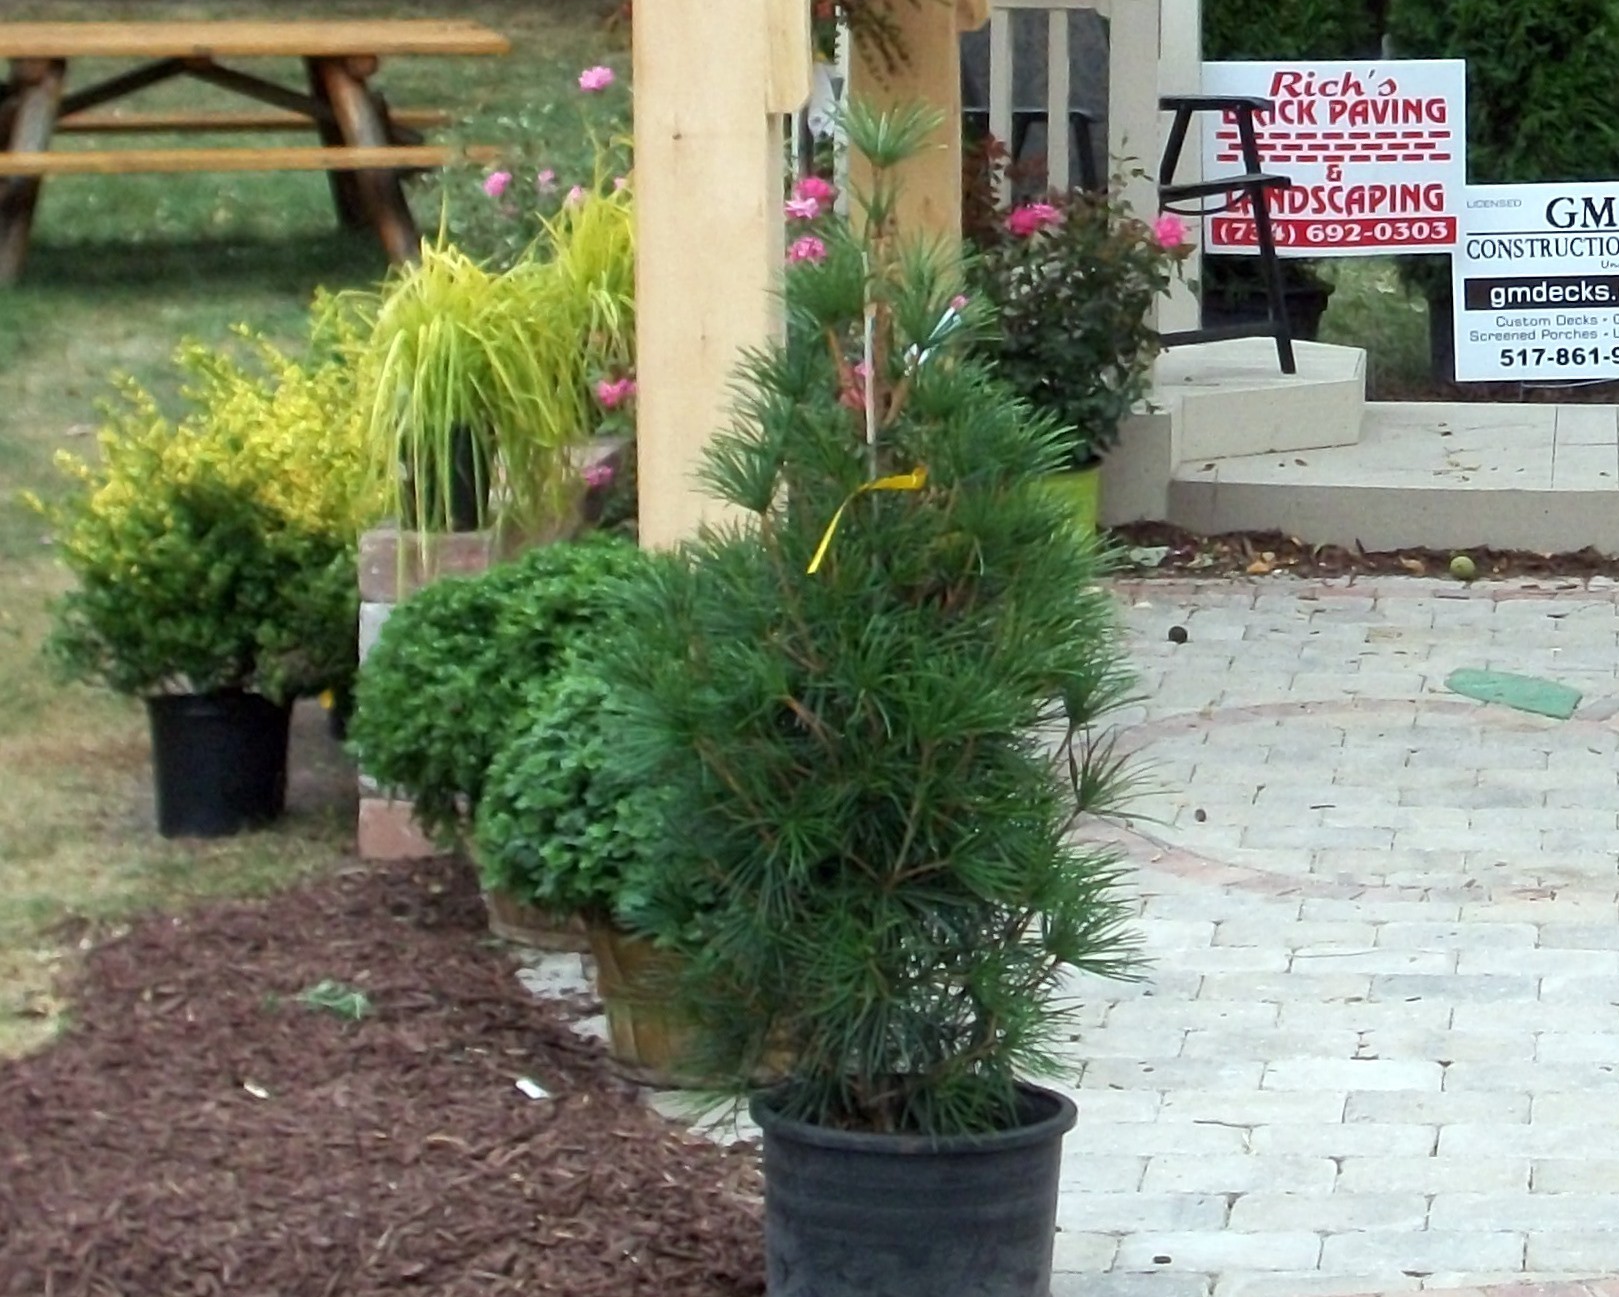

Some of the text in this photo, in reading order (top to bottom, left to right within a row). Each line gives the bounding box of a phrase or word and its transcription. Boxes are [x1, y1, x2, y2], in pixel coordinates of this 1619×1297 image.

[1269, 69, 1397, 97] Rich's
[1328, 98, 1447, 127] PAVING
[1326, 164, 1342, 182] &
[1466, 198, 1522, 209] LICENSED
[1545, 196, 1618, 229] GM
[1306, 222, 1449, 243] 692-0303
[1495, 315, 1551, 328] Custom
[1556, 314, 1599, 326] Decks
[1469, 329, 1536, 342] Screened
[1541, 329, 1598, 341] Porches
